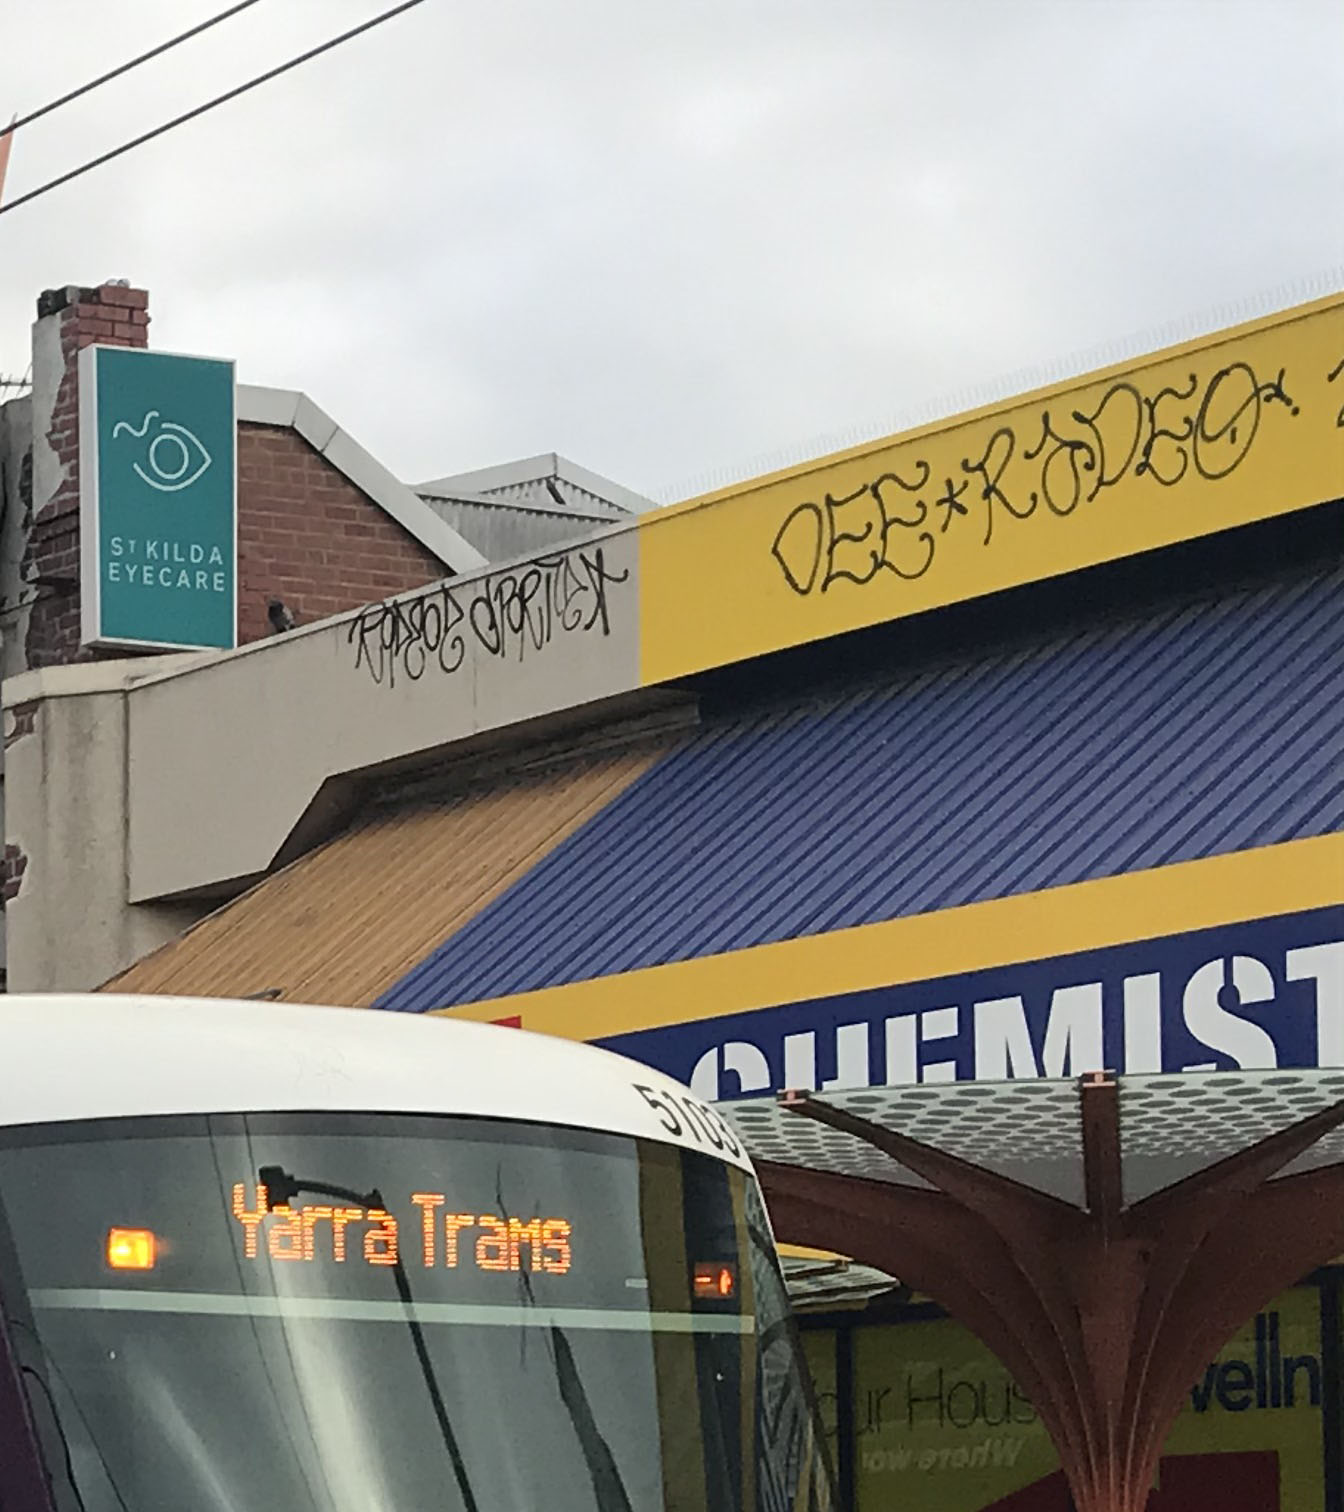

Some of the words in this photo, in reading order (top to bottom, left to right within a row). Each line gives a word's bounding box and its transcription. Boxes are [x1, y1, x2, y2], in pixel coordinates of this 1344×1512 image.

[108, 561, 226, 592] EYECARE
[145, 539, 224, 566] KILDA
[631, 1082, 741, 1159] 5103
[232, 1183, 399, 1265] Yarra
[411, 1192, 572, 1274] Trams
